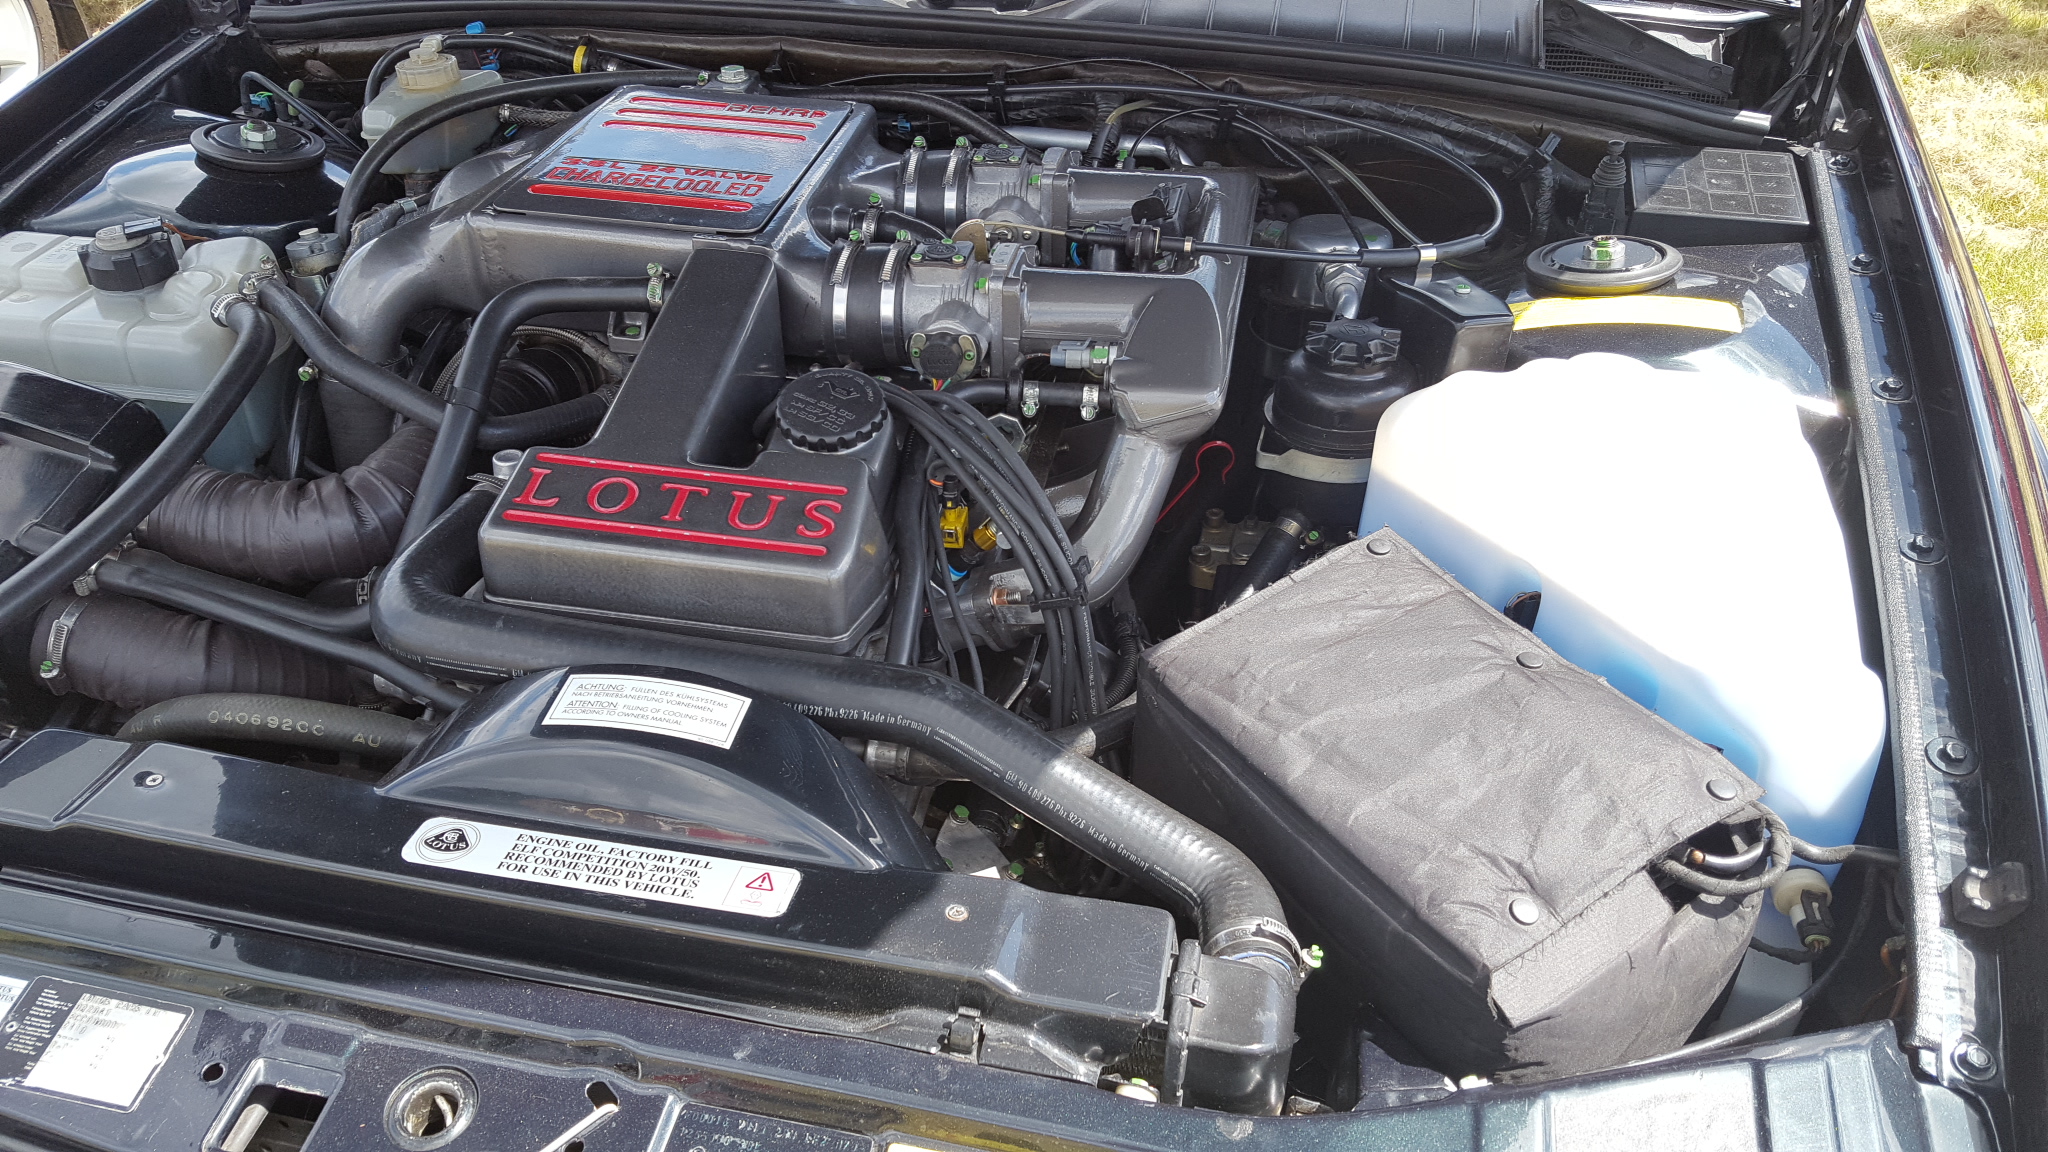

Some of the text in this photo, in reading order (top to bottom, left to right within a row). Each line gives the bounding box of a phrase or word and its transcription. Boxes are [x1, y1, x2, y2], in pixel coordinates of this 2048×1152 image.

[545, 166, 765, 197] CHARGECOOLED
[512, 467, 843, 538] LOTUS
[575, 683, 627, 692] ACHTUNG:
[660, 690, 674, 698] DES
[676, 692, 729, 709] KÜHLSYSTEMS
[665, 699, 713, 713] VORNEHMEN
[562, 708, 604, 716] ACCORDING
[617, 711, 649, 720] OWNERS
[650, 715, 682, 726] MANUAL
[566, 700, 620, 709] ATTENTION:
[623, 704, 649, 713] FILLING
[663, 709, 698, 721] COOLING
[700, 716, 727, 728] SYSTEM
[839, 708, 859, 719] 9226
[863, 711, 885, 722] Made
[887, 713, 895, 724] in
[896, 714, 932, 736] Germany
[352, 732, 382, 747] AU
[426, 836, 467, 851] LOTUS
[1040, 795, 1056, 809] 276
[1068, 812, 1086, 829] 9226
[1088, 826, 1107, 843] Made
[1108, 838, 1116, 849] in
[1117, 844, 1149, 872] Germany
[511, 843, 701, 879] ELF COMPETITION 20W/50.
[516, 833, 713, 870] ENGINE OIL, FACTORY FILL
[496, 861, 695, 899] FOR USE IN THIS VEHICLE.
[503, 852, 700, 888] RECOMMENDED BY LOTUS
